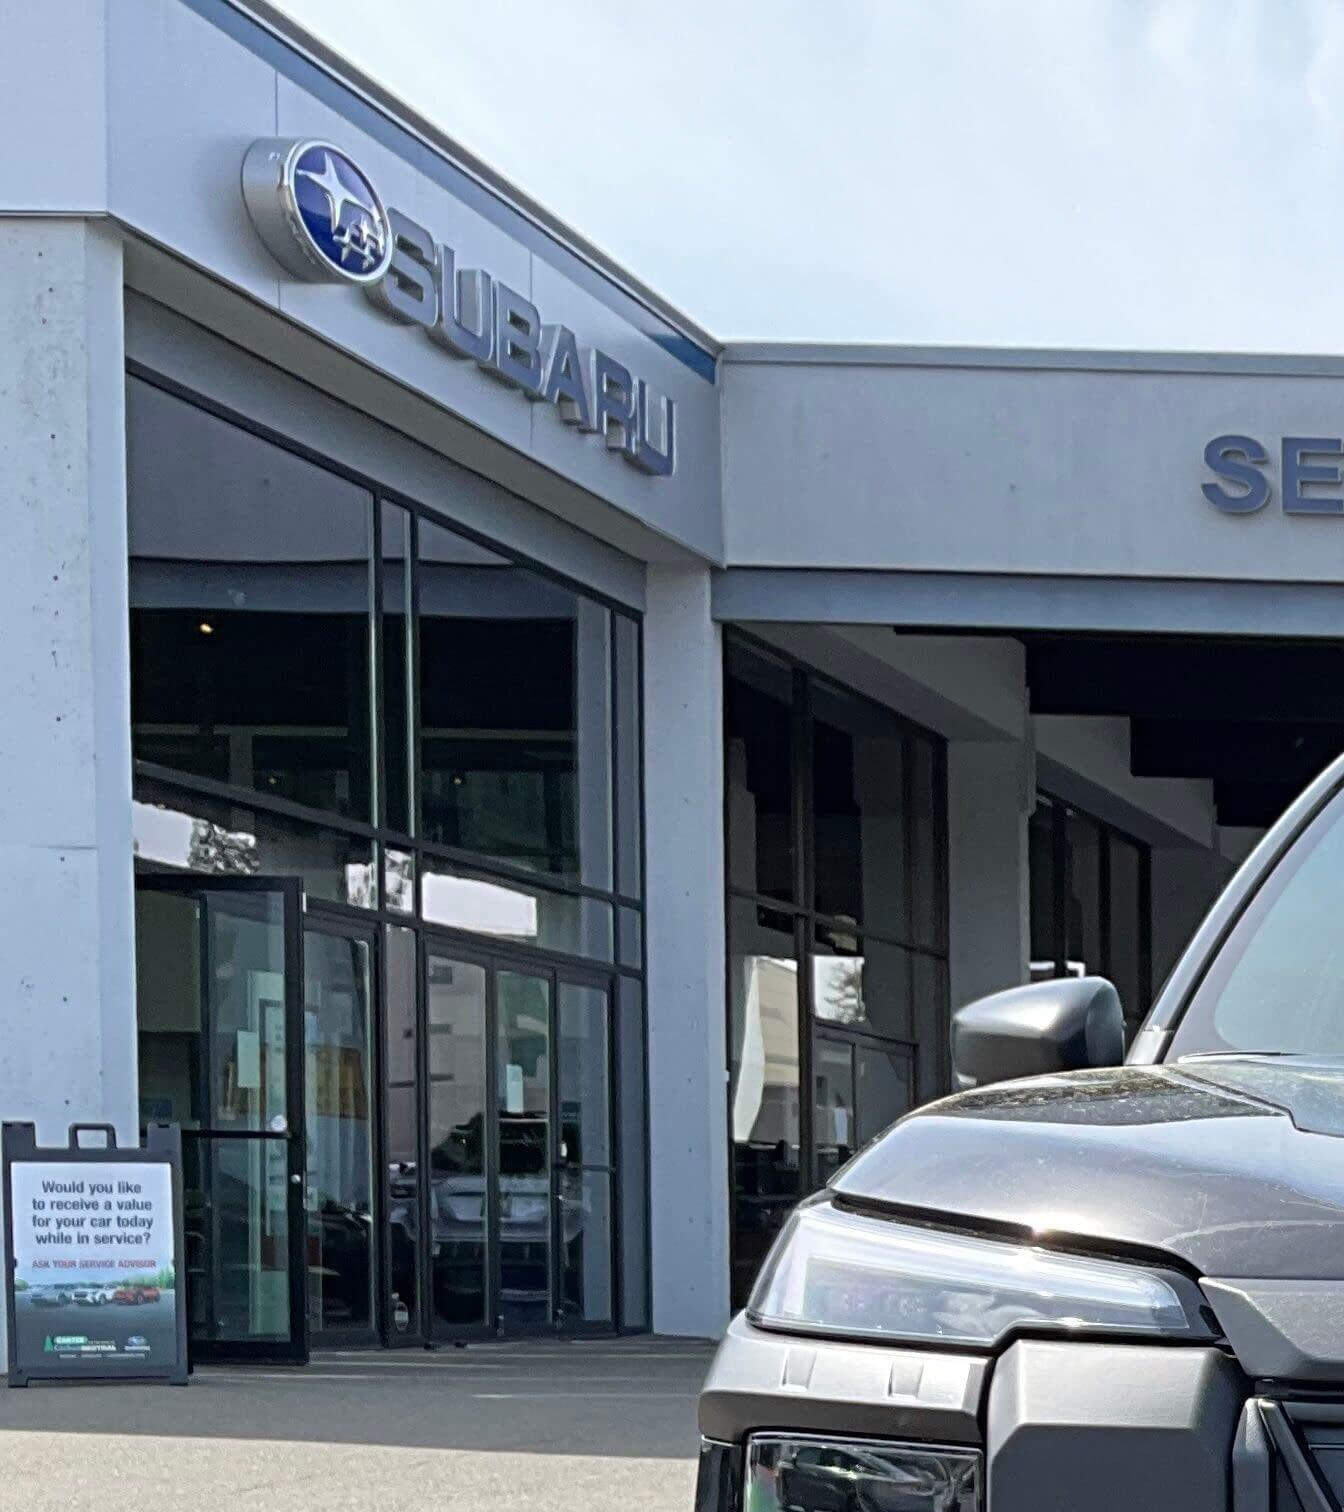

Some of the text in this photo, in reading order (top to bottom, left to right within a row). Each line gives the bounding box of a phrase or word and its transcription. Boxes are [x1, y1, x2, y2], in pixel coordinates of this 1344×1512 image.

[368, 205, 678, 477] SUBARU
[43, 1180, 142, 1195] Would you like
[32, 1198, 153, 1210] to receive a value
[32, 1215, 154, 1230] for your car today
[36, 1232, 152, 1244] while in service?
[32, 1260, 156, 1268] ASK YOUR SERVICE ADVISOR
